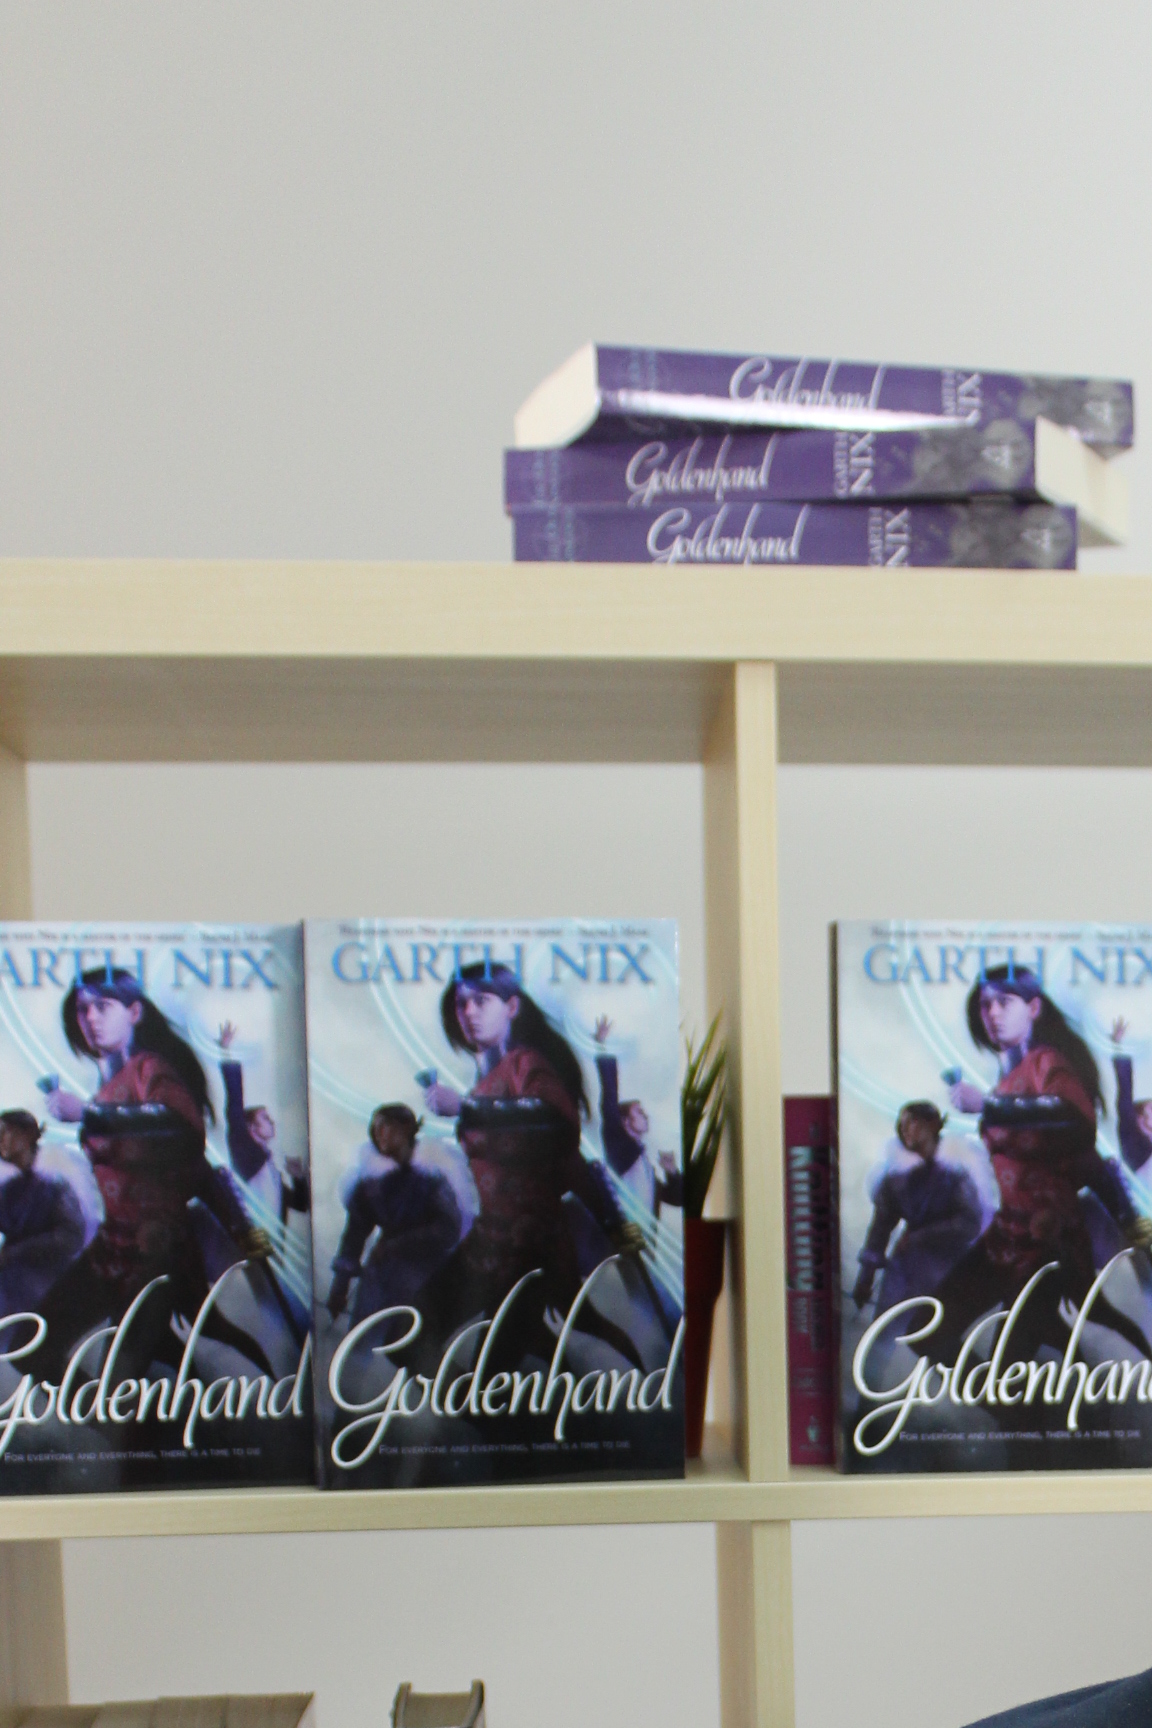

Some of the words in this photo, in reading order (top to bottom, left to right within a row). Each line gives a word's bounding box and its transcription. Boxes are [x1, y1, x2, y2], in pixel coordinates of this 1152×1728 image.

[625, 431, 780, 508] Goldenhand
[833, 431, 849, 499] GARTH
[849, 431, 875, 497] NIX
[646, 502, 812, 567] Goldenhand
[884, 507, 912, 567] NIX
[0, 946, 148, 988] ARTH
[171, 946, 277, 989] NIX
[331, 941, 525, 984] GARTH
[549, 942, 656, 984] NIX
[863, 942, 1045, 985] GARTH
[328, 1252, 686, 1469] Goldenhand
